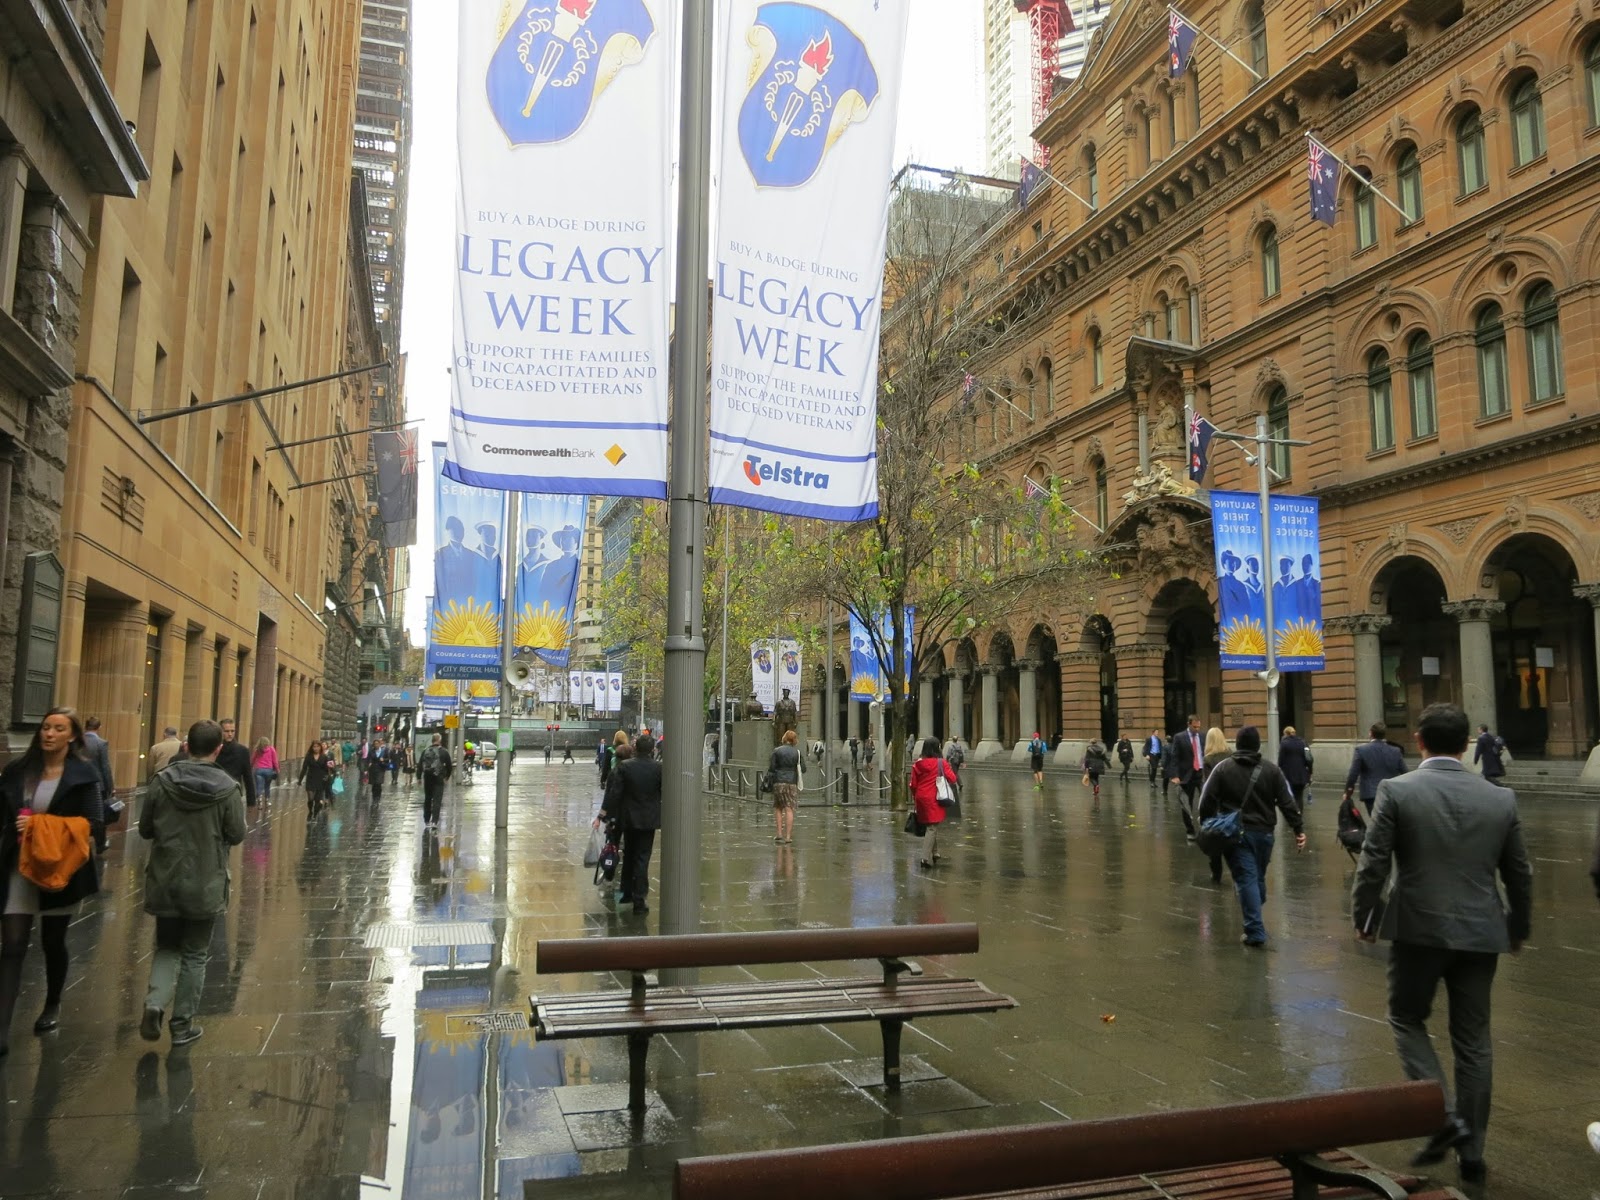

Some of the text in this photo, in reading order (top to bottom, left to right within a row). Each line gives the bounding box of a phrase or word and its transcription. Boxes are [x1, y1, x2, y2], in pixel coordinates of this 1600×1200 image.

[478, 211, 646, 232] BUY A BADGE DURING
[459, 233, 664, 284] LEGACY
[729, 240, 858, 283] BUY A BADGE DURING
[717, 260, 875, 331] LEGACY
[483, 291, 636, 335] WEEK
[542, 348, 574, 361] THE
[579, 349, 650, 363] FAMILIES
[734, 316, 846, 376] WEEK
[457, 355, 657, 379] OF INCAPACITATED AND
[471, 375, 643, 395] DECEASED VETERANS
[772, 378, 796, 393] THE
[801, 383, 859, 402] FAMILIES
[716, 378, 730, 392] OF
[835, 405, 866, 417] AND
[786, 411, 853, 431] VETERANS
[746, 454, 830, 489] Telstra
[441, 485, 500, 498] SERVICE
[459, 666, 483, 674] RECITAL
